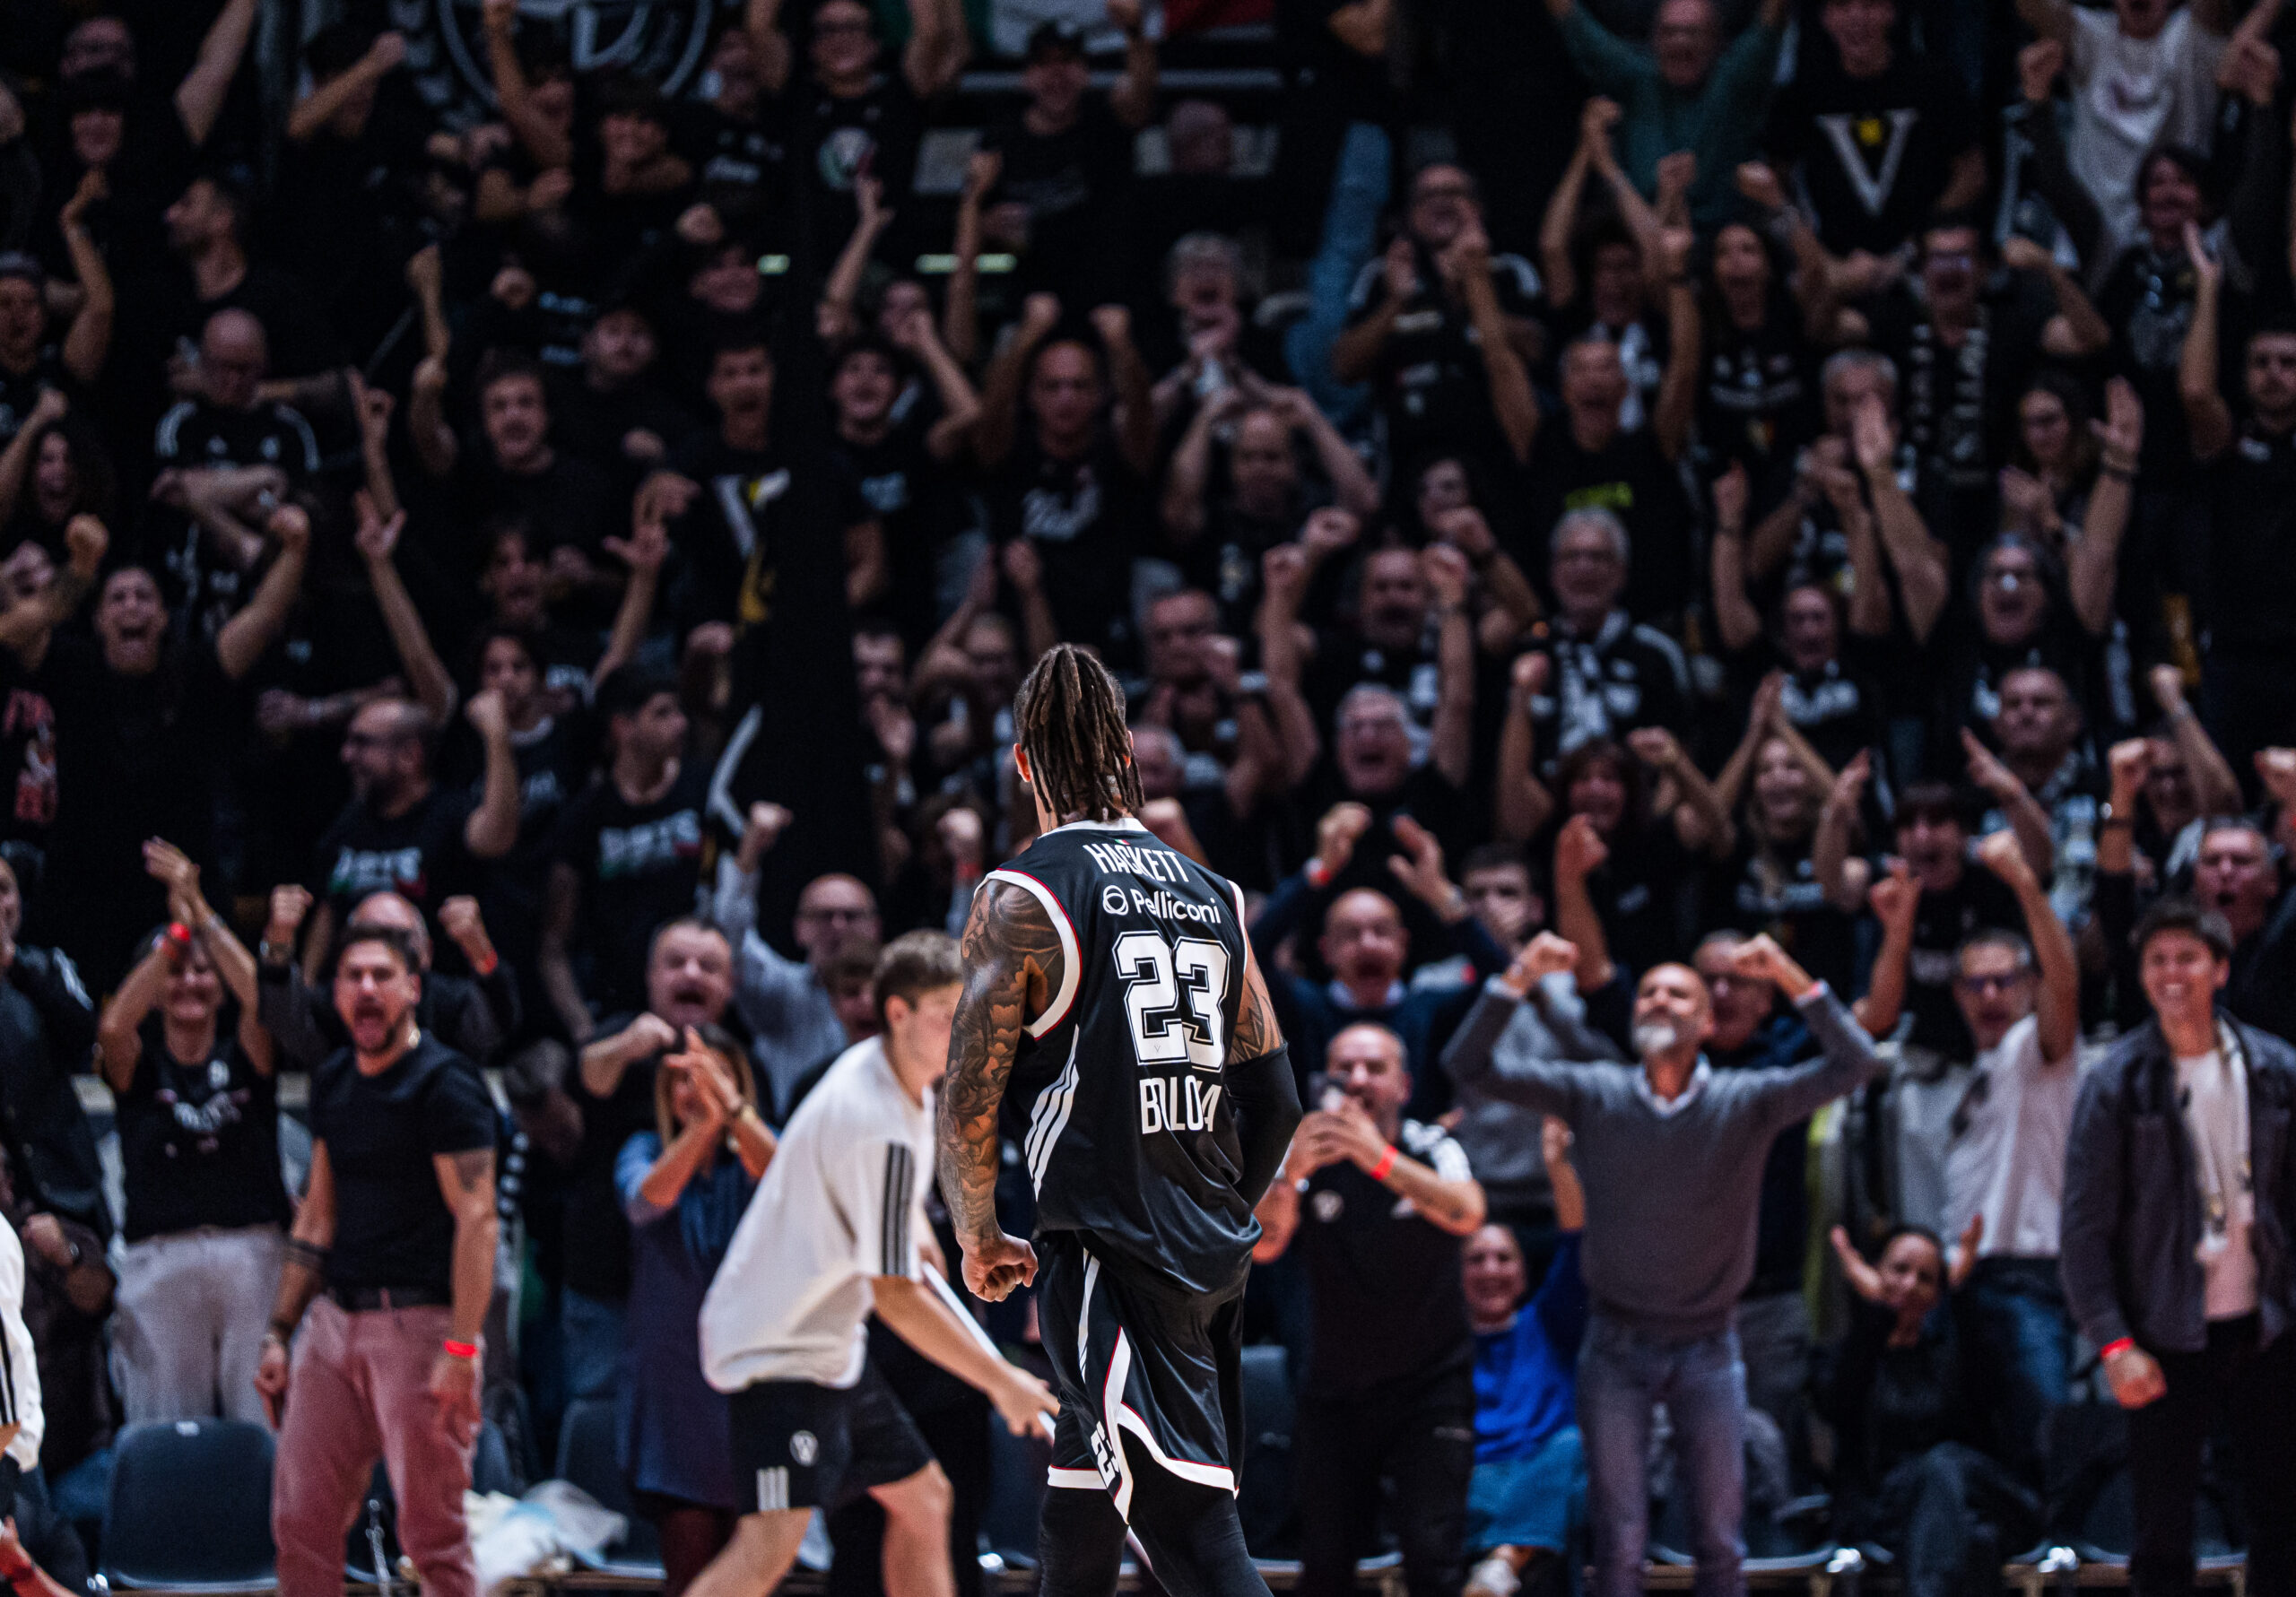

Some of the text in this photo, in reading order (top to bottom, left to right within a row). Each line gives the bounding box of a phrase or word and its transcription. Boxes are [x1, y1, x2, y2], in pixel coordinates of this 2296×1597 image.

[1083, 843, 1190, 882] HACKETT
[1130, 888, 1222, 924] Pelliconi
[1111, 930, 1231, 1073] 23
